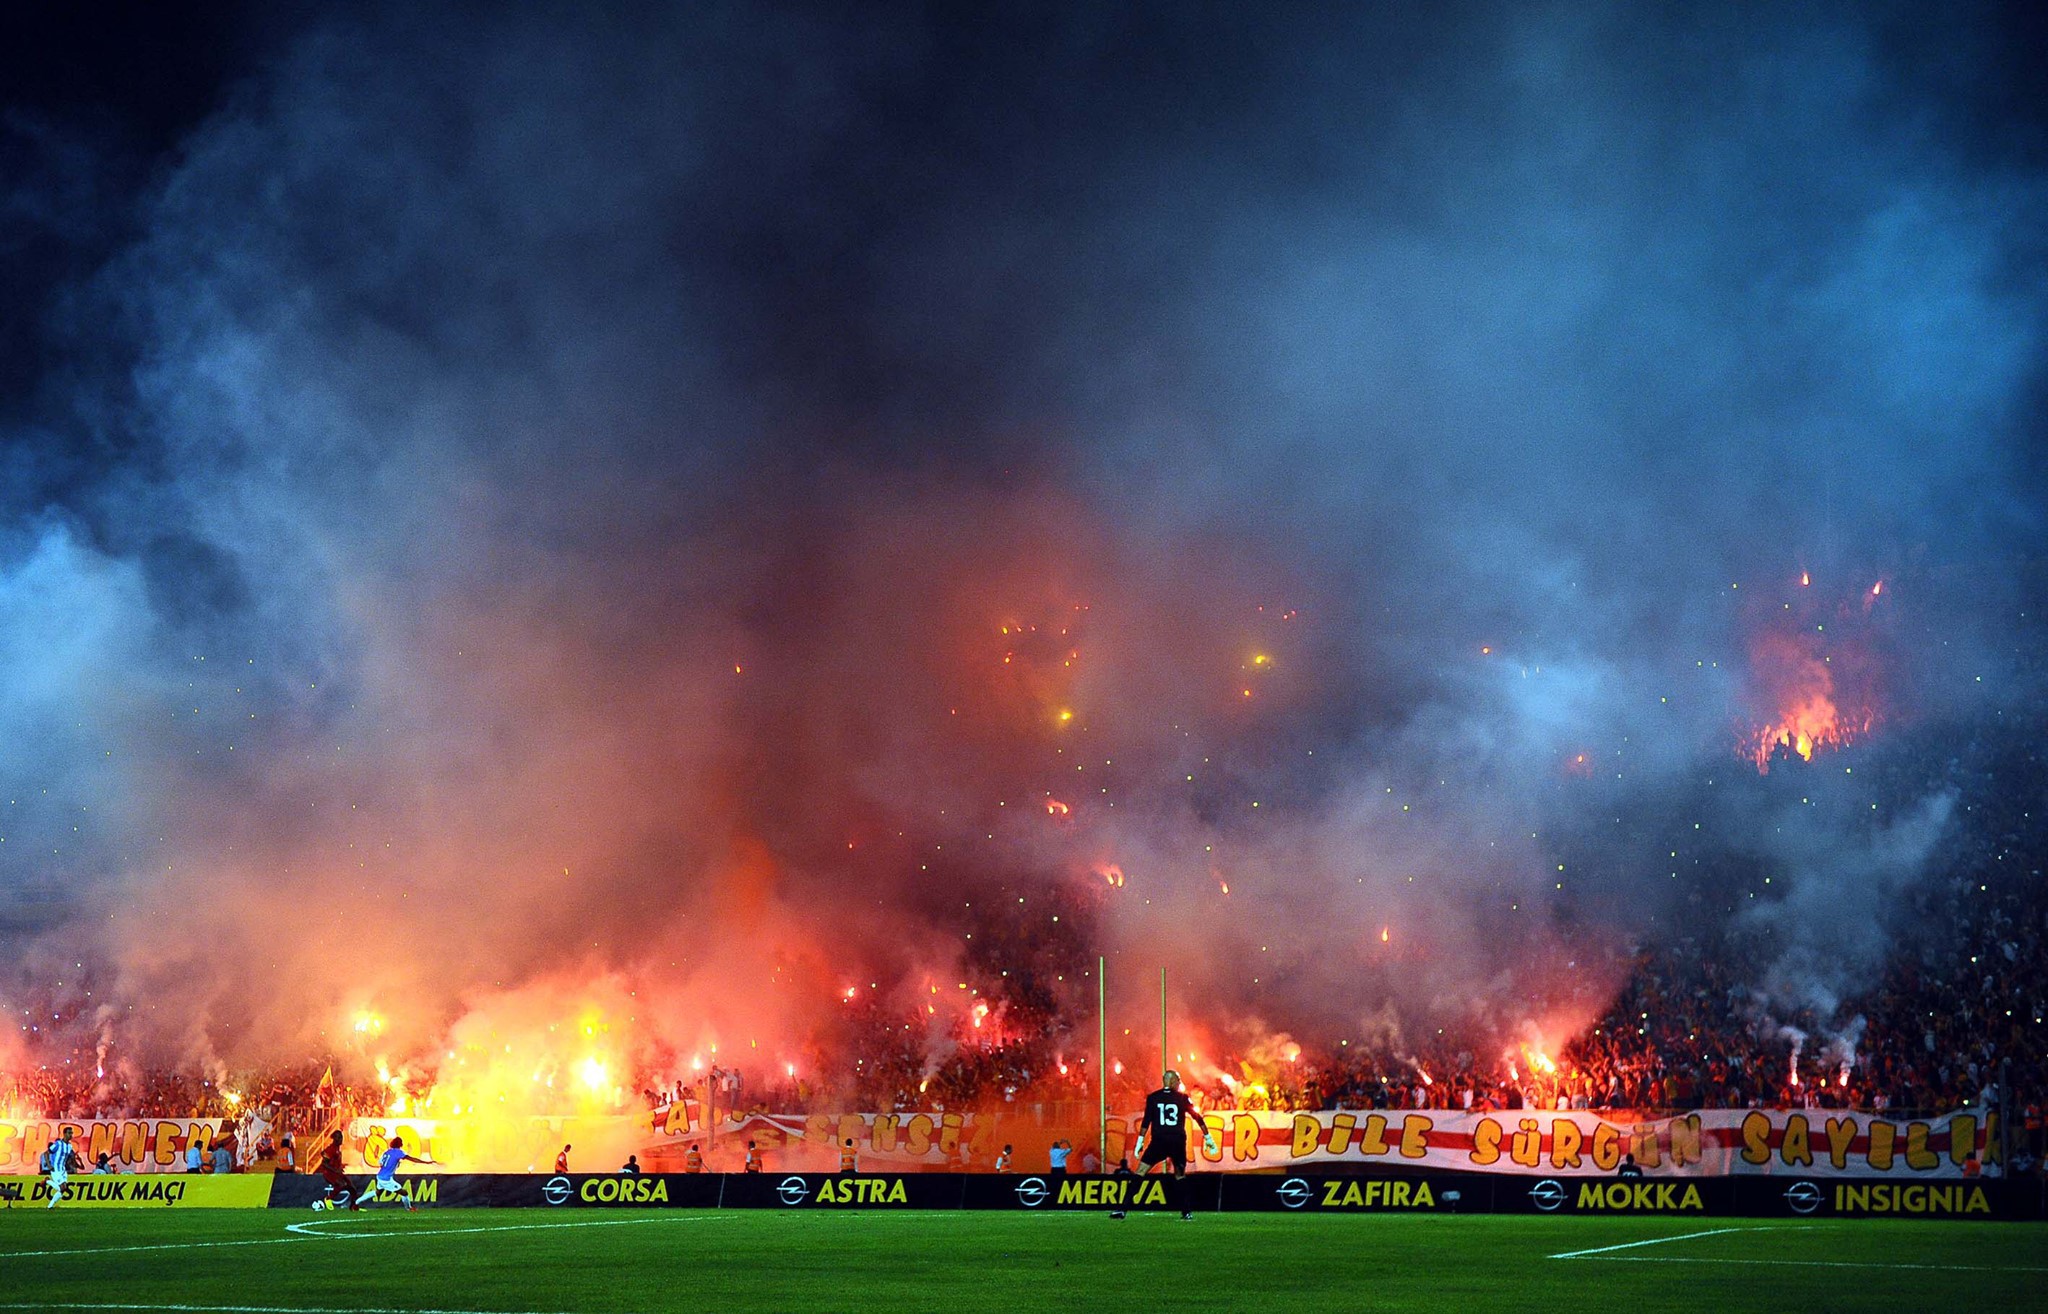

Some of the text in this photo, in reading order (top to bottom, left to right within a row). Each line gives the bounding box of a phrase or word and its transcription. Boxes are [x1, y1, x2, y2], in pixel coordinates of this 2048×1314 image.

[1157, 1103, 1178, 1126] 13
[1291, 1113, 1434, 1159] BİLE
[1469, 1113, 1702, 1171] SÜRGÜN
[131, 1181, 186, 1206] MAÇI
[580, 1178, 669, 1203] CORSA
[816, 1178, 908, 1203] ASTRA
[1321, 1180, 1436, 1207] ZAFIRA
[1577, 1182, 1704, 1209] MOKKA
[1835, 1184, 1991, 1213] INSIGNIA
